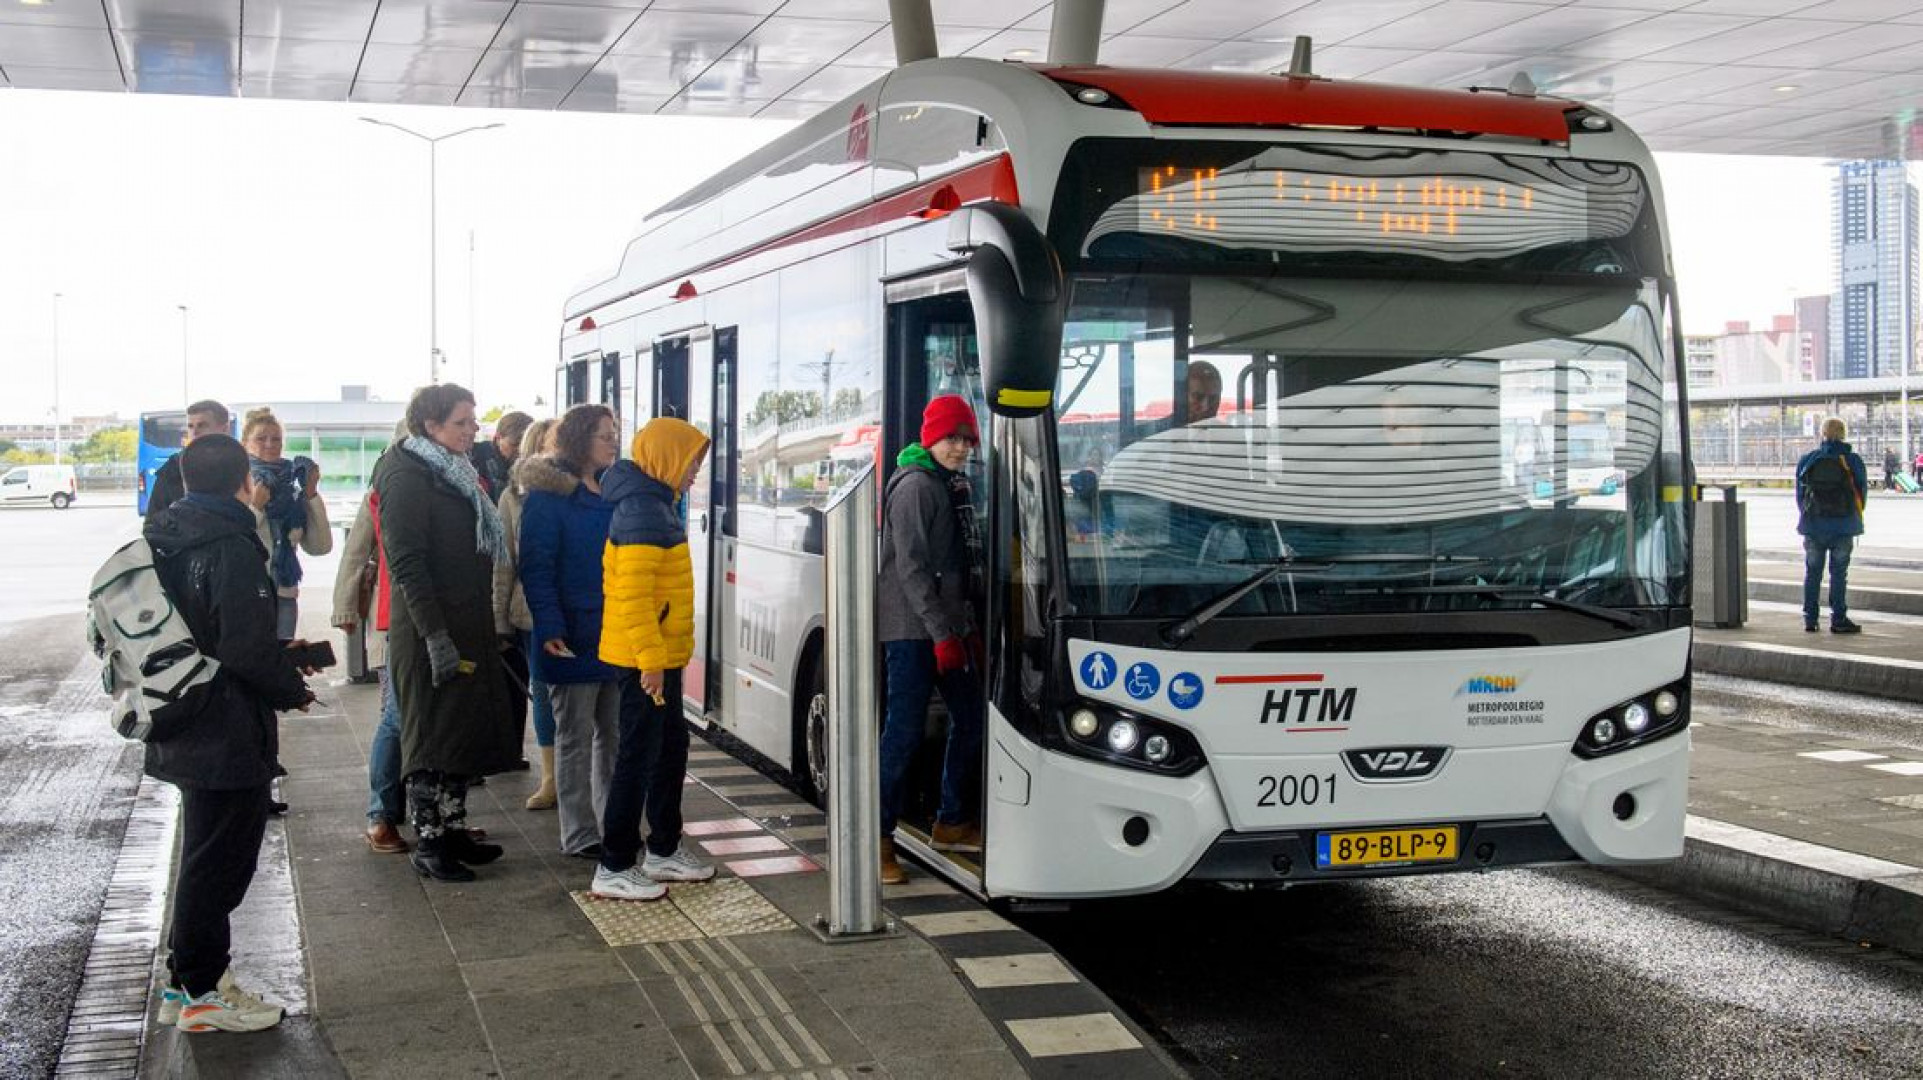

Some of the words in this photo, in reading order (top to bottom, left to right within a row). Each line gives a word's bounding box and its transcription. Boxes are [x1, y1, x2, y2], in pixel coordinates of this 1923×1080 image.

[1260, 687, 1358, 723] HTM
[1468, 701, 1544, 712] METROPOOLREGIO
[1360, 751, 1430, 772] VDL
[1257, 773, 1336, 806] 2001
[1338, 832, 1447, 861] 89-BLP-9
